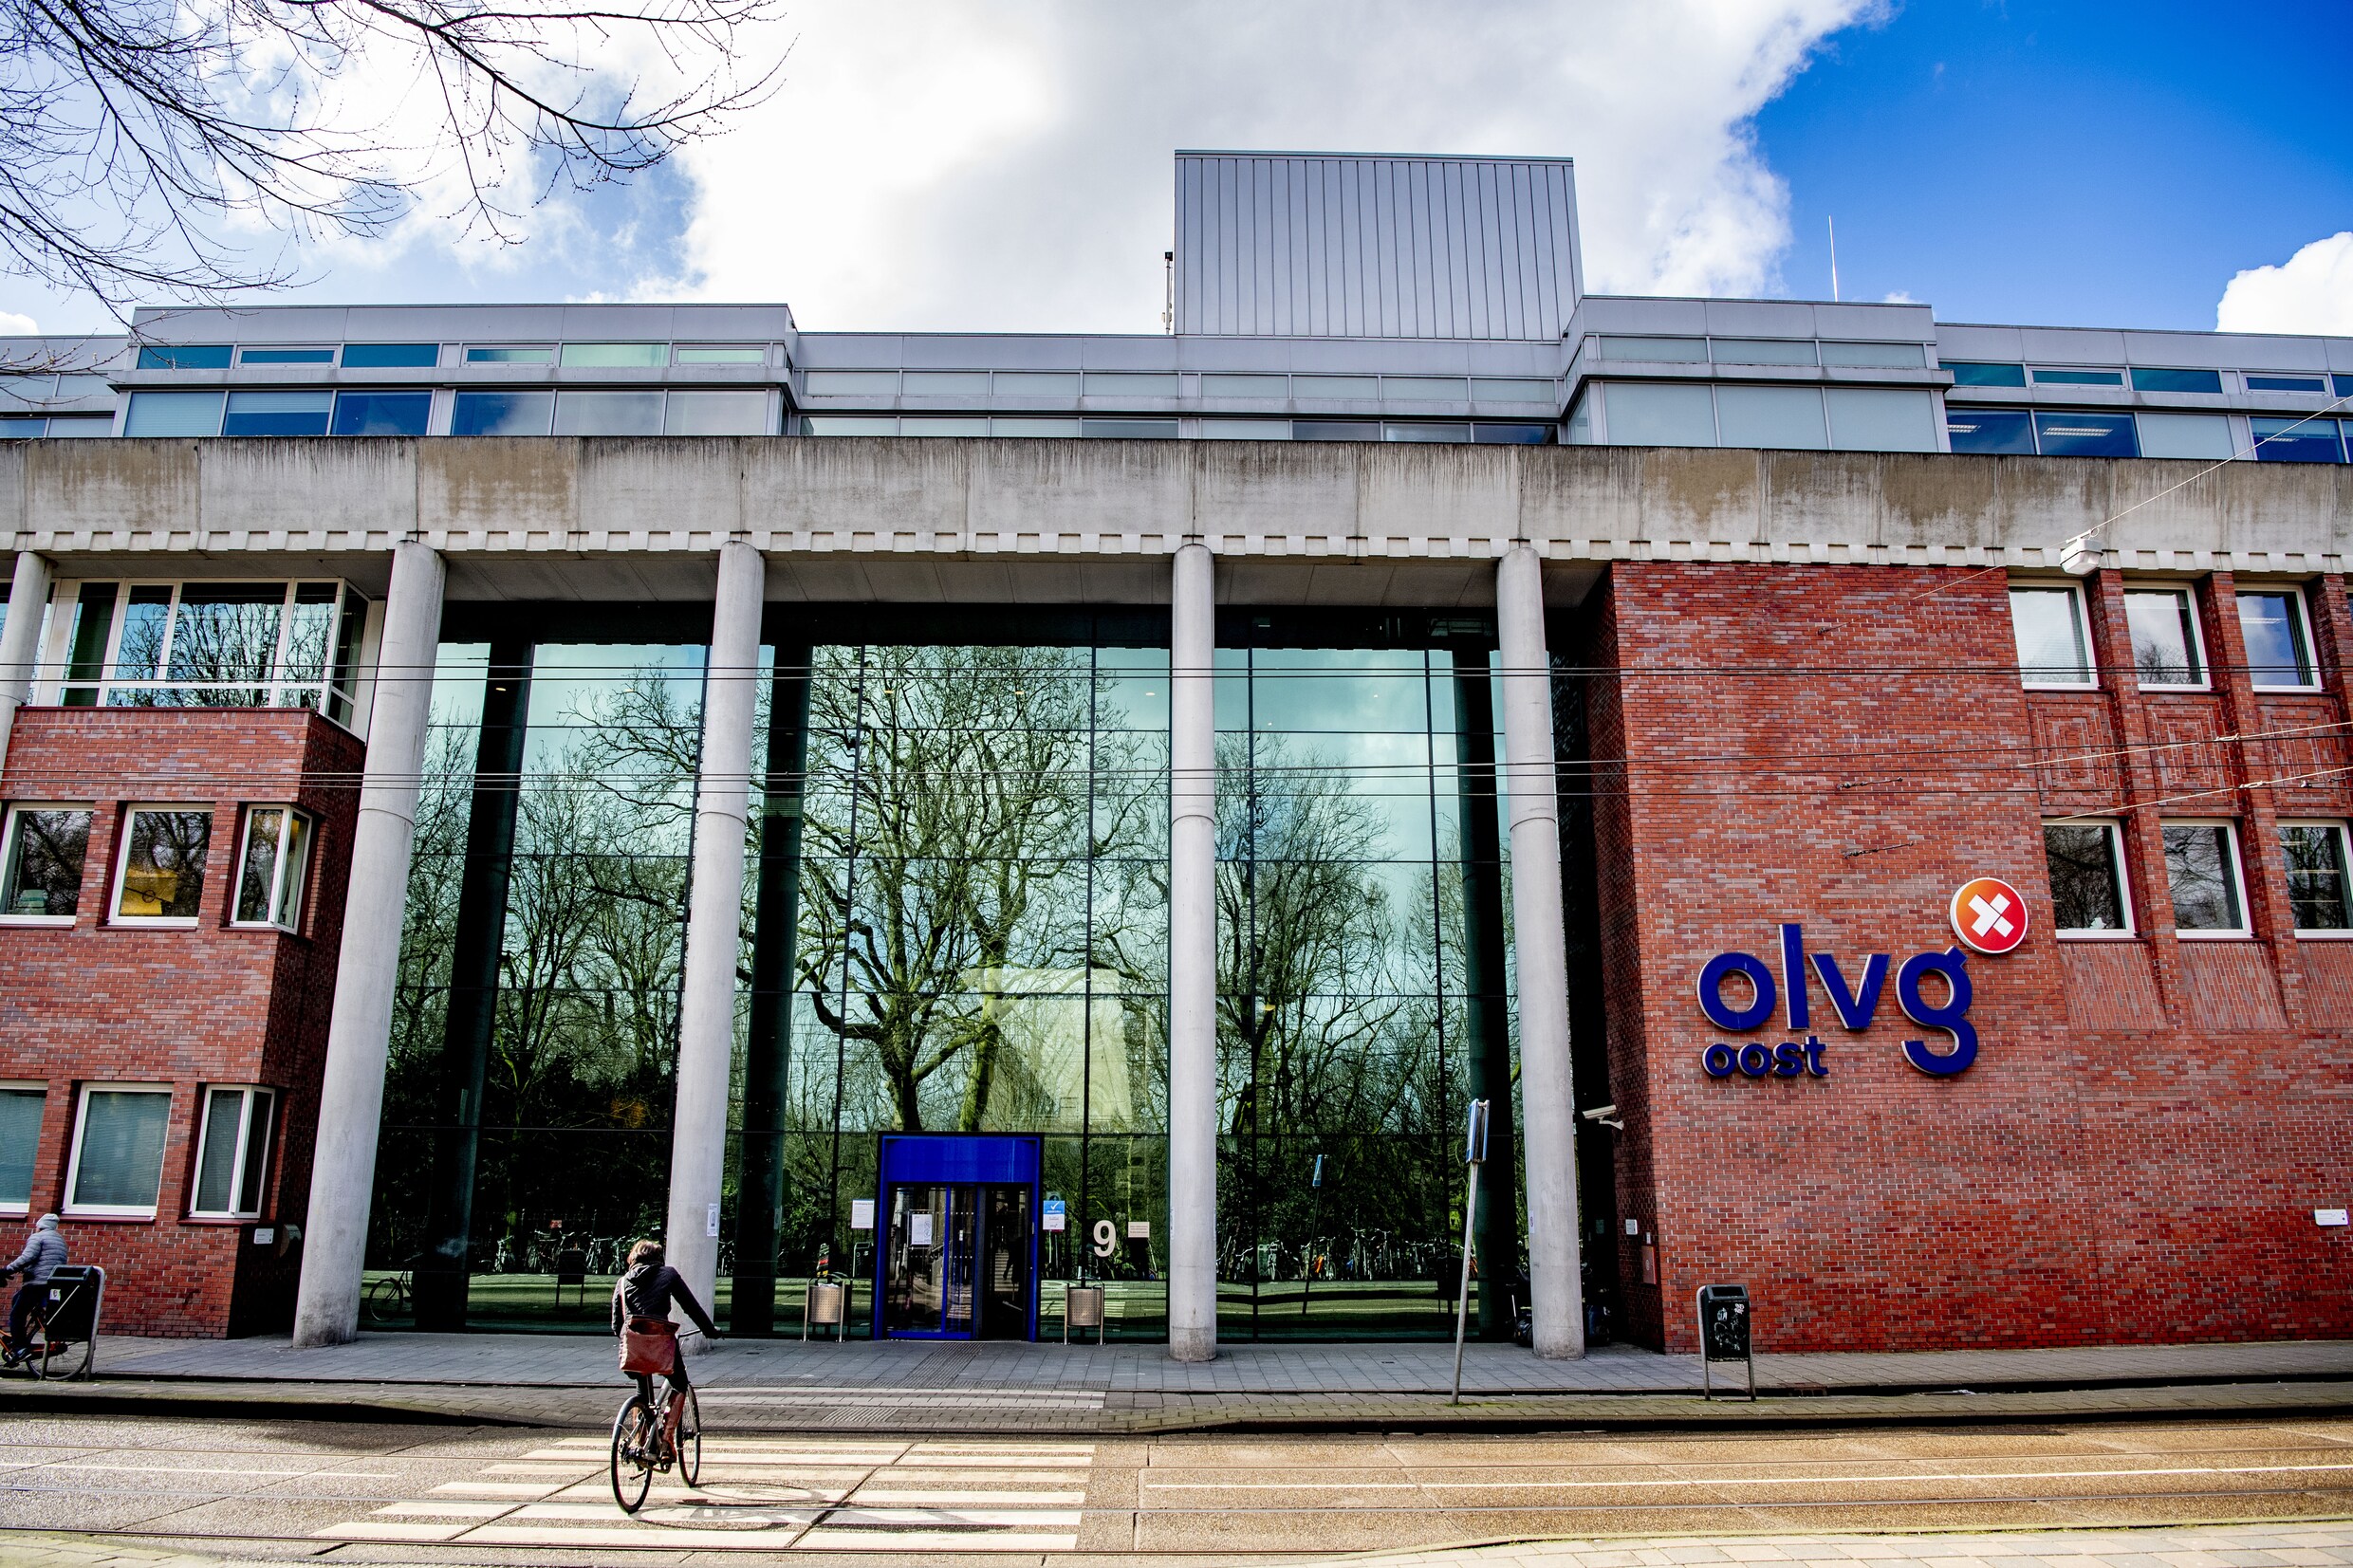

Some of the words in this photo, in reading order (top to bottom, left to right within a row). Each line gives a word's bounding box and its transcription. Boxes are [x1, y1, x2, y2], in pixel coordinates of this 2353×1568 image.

[1697, 923, 1978, 1076] olvg
[1702, 1036, 1829, 1078] oost
[1093, 1219, 1117, 1257] 9
